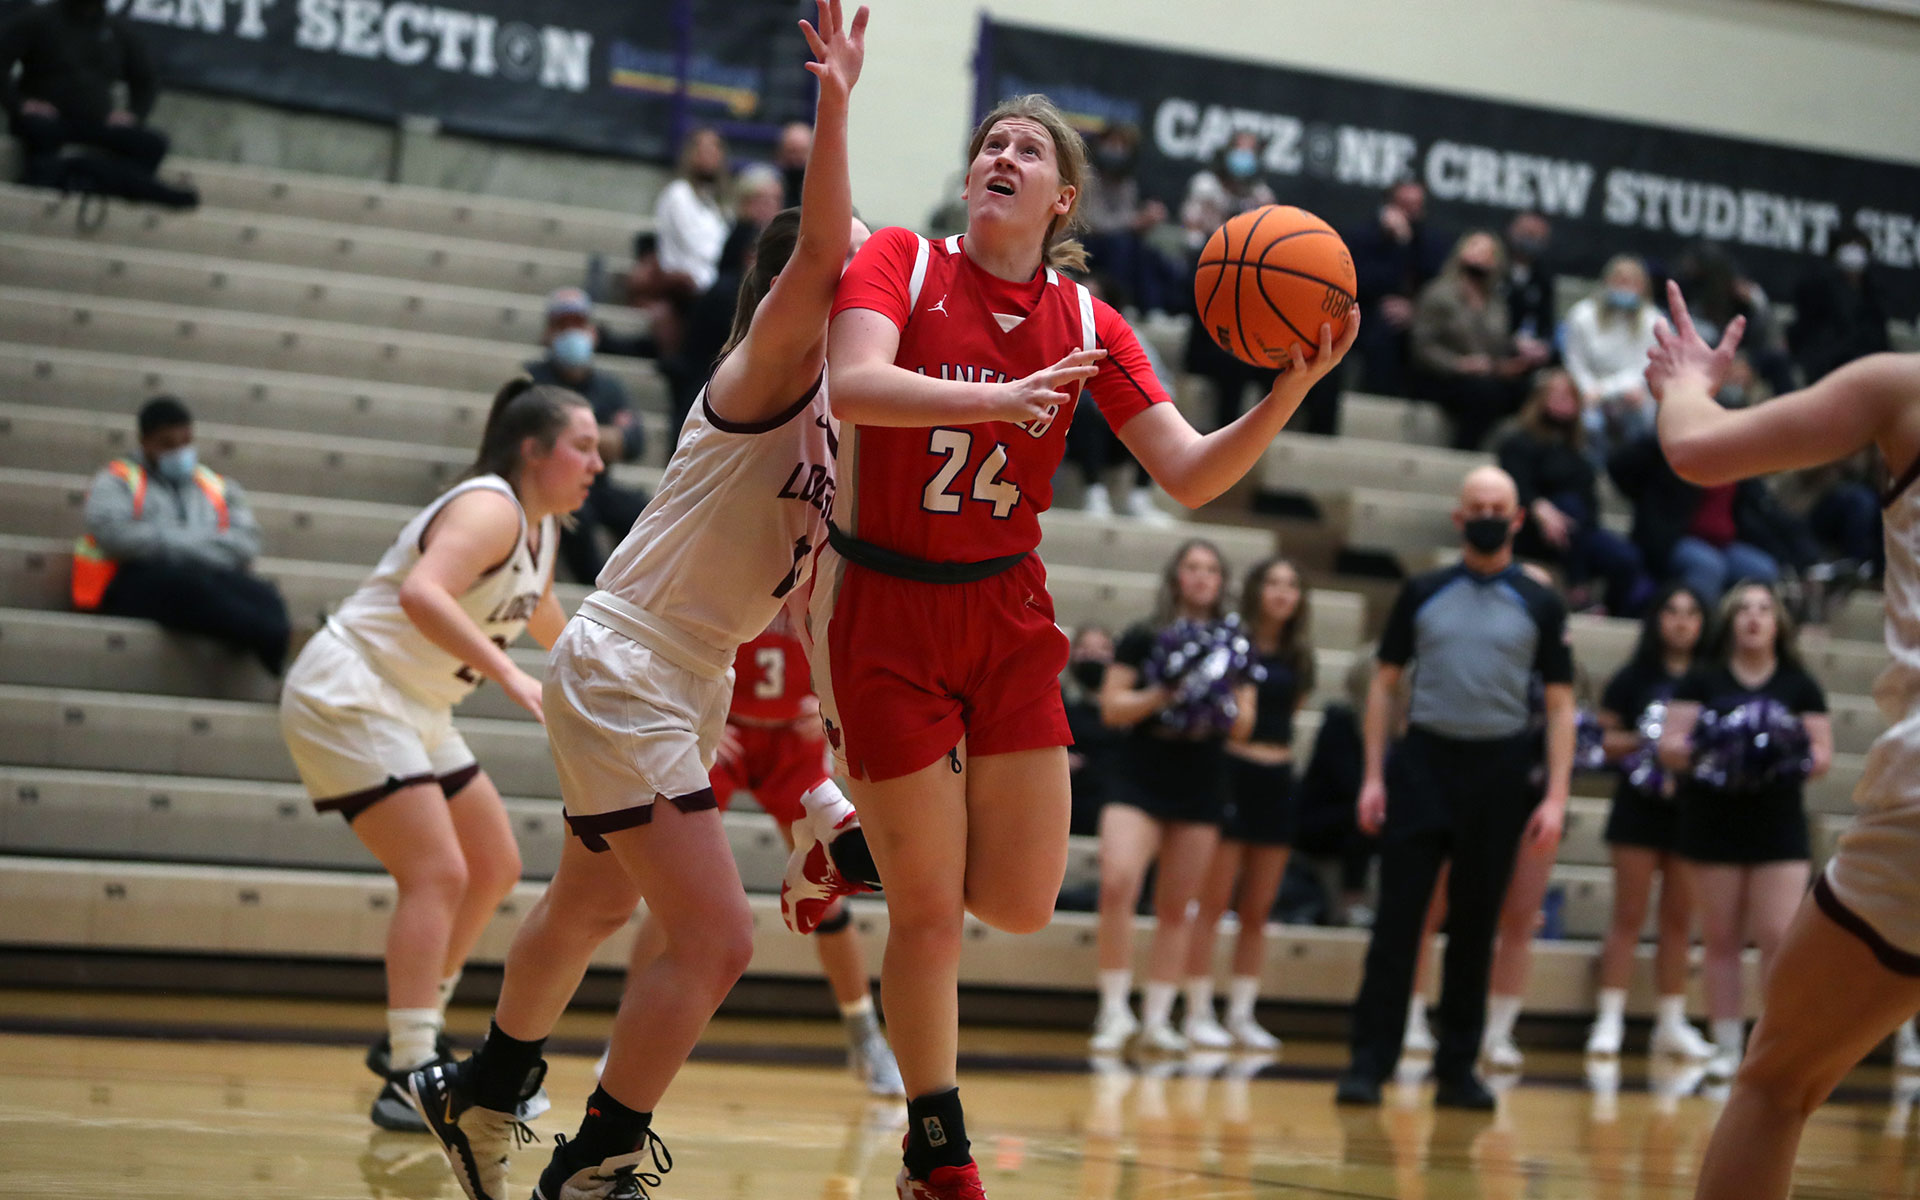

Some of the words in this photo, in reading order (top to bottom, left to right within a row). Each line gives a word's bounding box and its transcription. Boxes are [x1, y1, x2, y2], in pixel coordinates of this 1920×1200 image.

[1424, 138, 1597, 219] CREW
[1603, 166, 1840, 256] STUDENT
[1854, 207, 1920, 270] SE
[920, 425, 1023, 521] 24
[754, 648, 786, 698] 3
